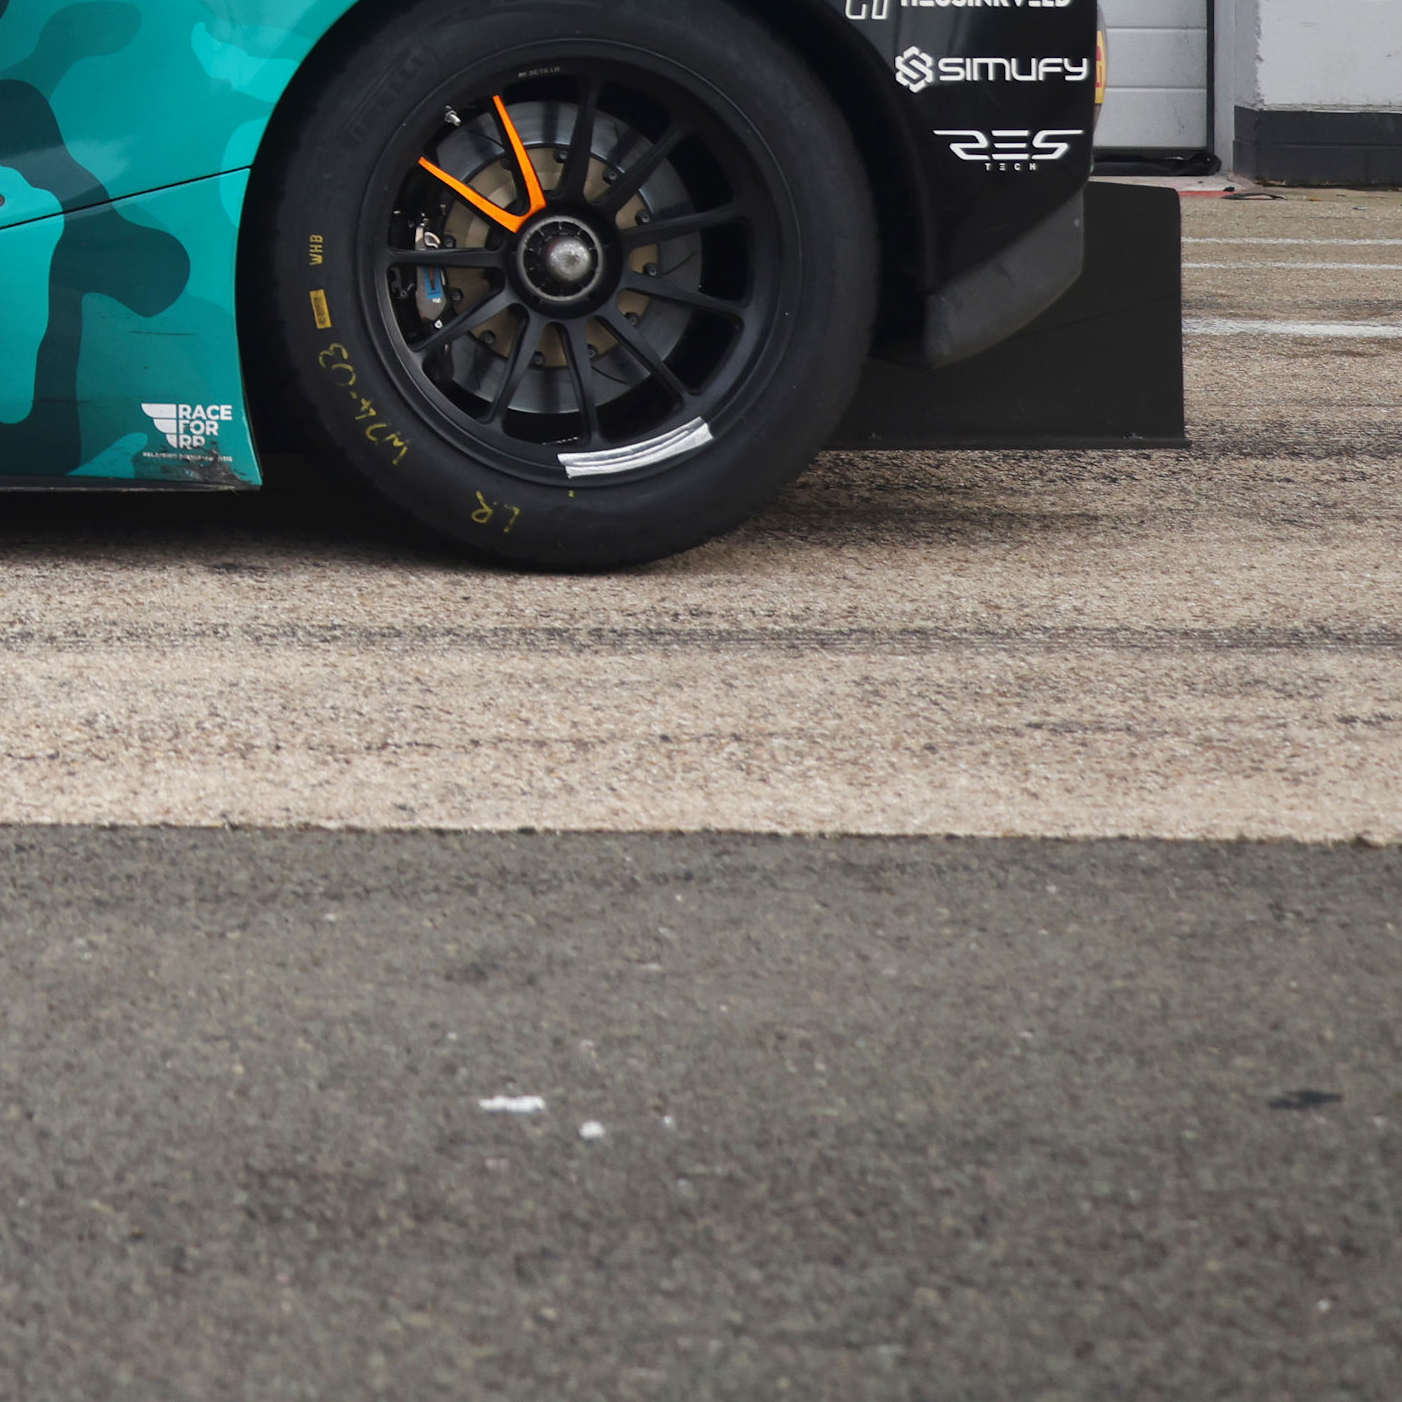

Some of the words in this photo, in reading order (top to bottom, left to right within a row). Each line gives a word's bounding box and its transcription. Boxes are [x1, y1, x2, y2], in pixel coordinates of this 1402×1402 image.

[984, 162, 1037, 171] TECH
[178, 403, 233, 420] RACE
[178, 419, 219, 436] FOR
[178, 434, 206, 450] RP
